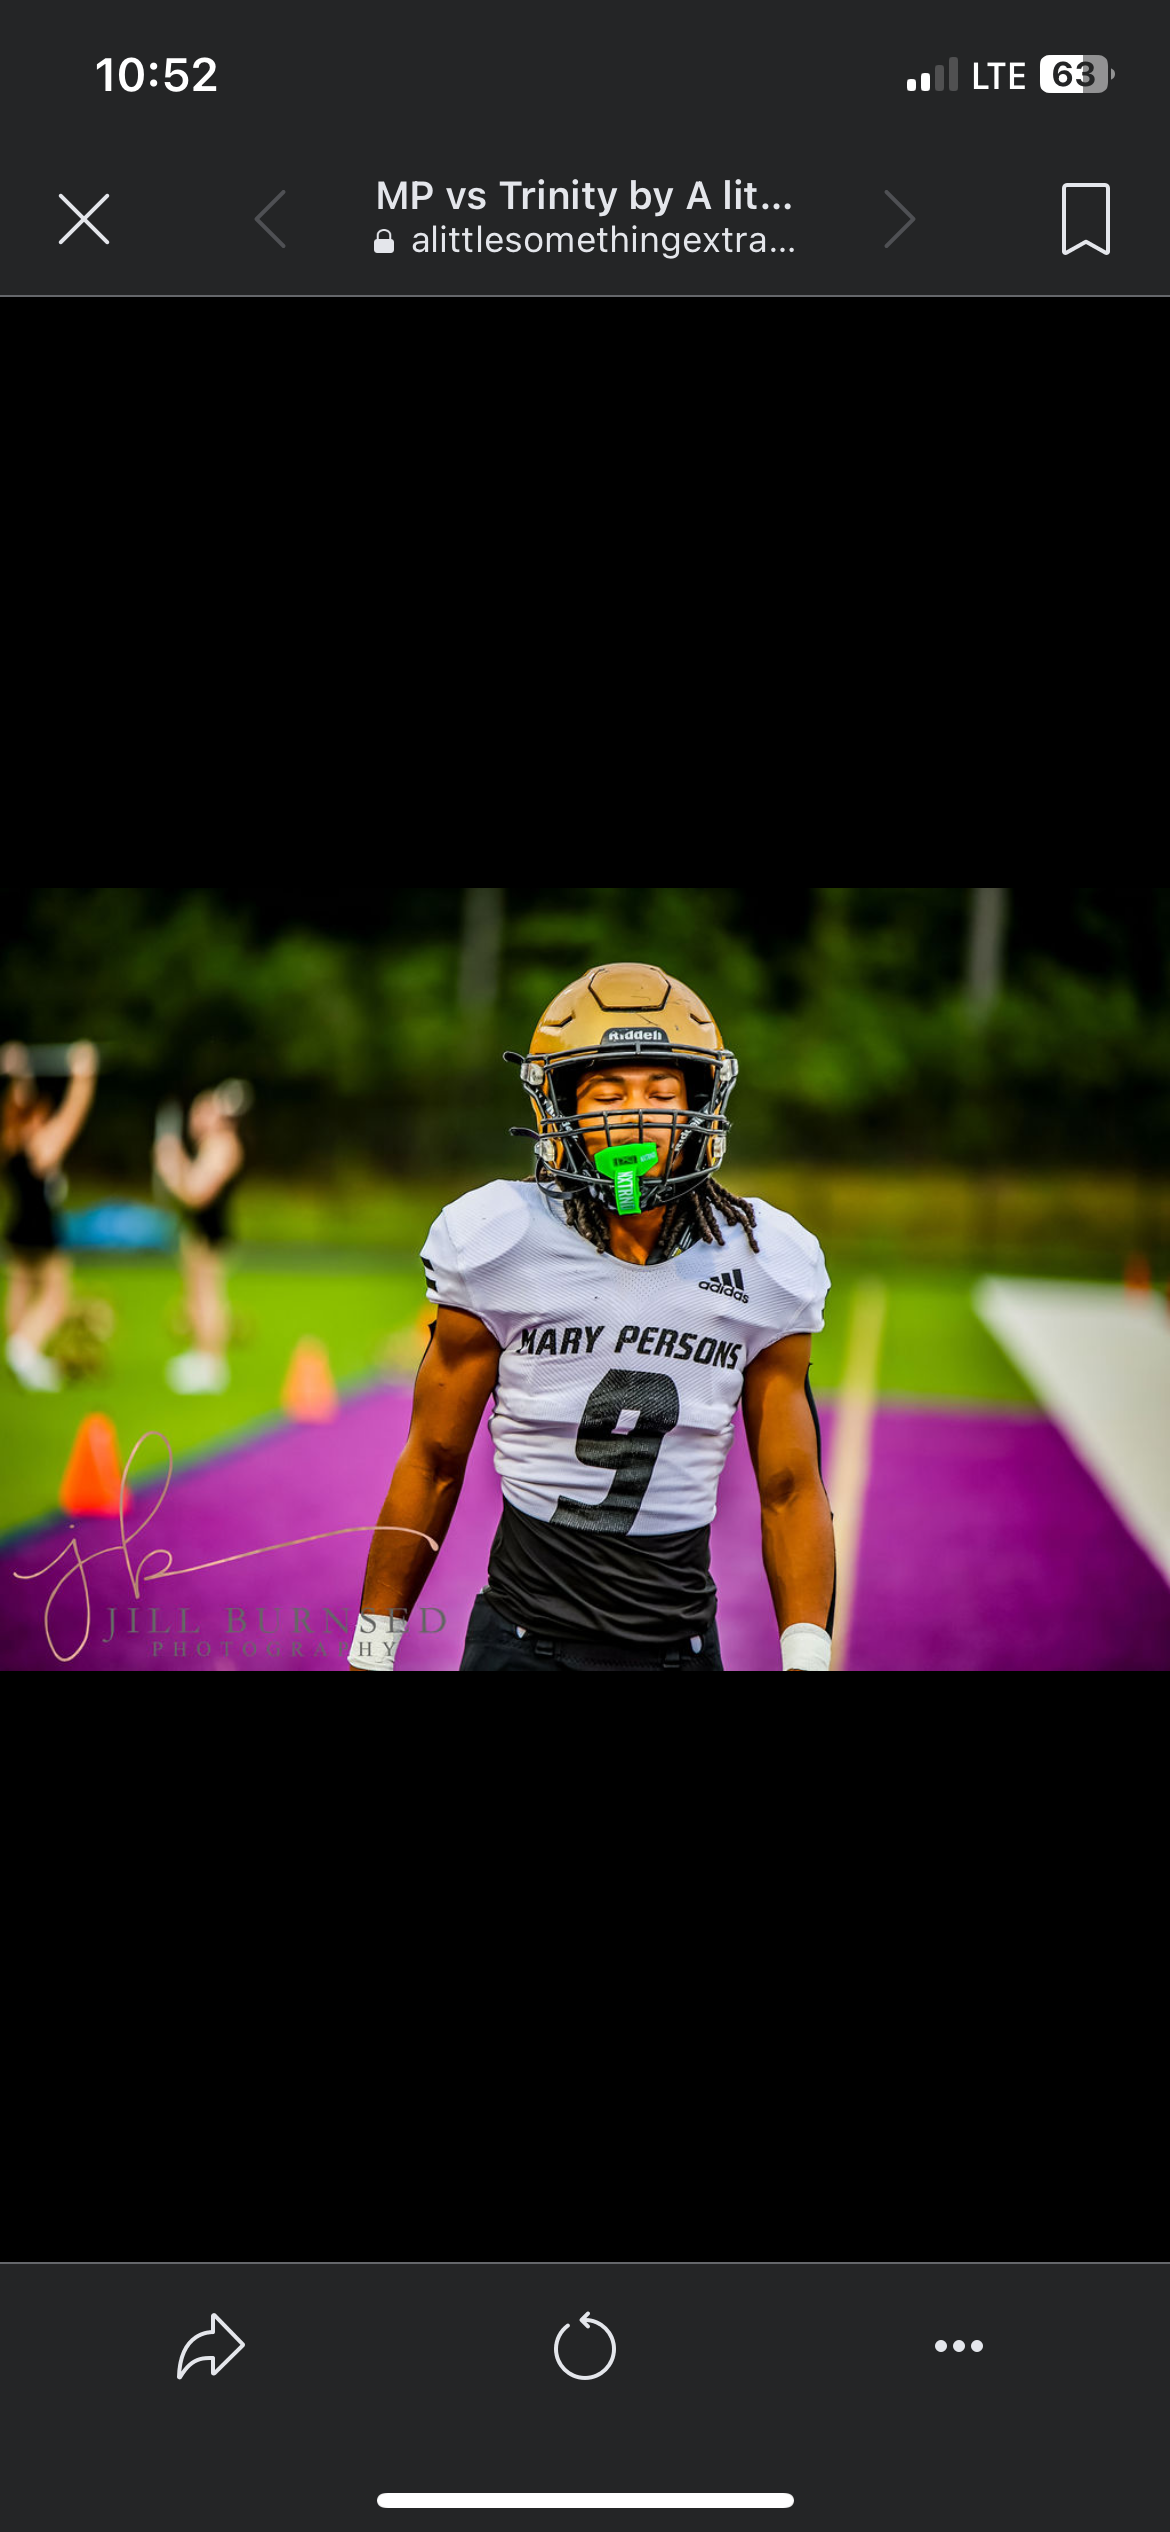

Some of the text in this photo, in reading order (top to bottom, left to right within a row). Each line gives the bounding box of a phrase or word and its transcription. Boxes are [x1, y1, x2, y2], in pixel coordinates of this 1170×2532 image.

[96, 56, 217, 93] 10:52
[973, 61, 1026, 90] LTE
[1052, 61, 1095, 87] 63
[377, 180, 434, 210] MP
[445, 187, 487, 211] vs
[499, 178, 618, 218] Trinity
[630, 179, 674, 218] by
[685, 180, 712, 210] A
[608, 1030, 662, 1041] Riddell
[698, 1281, 750, 1304] adidas
[516, 1325, 743, 1370] MARY PERSONS
[550, 1368, 681, 1537] 9
